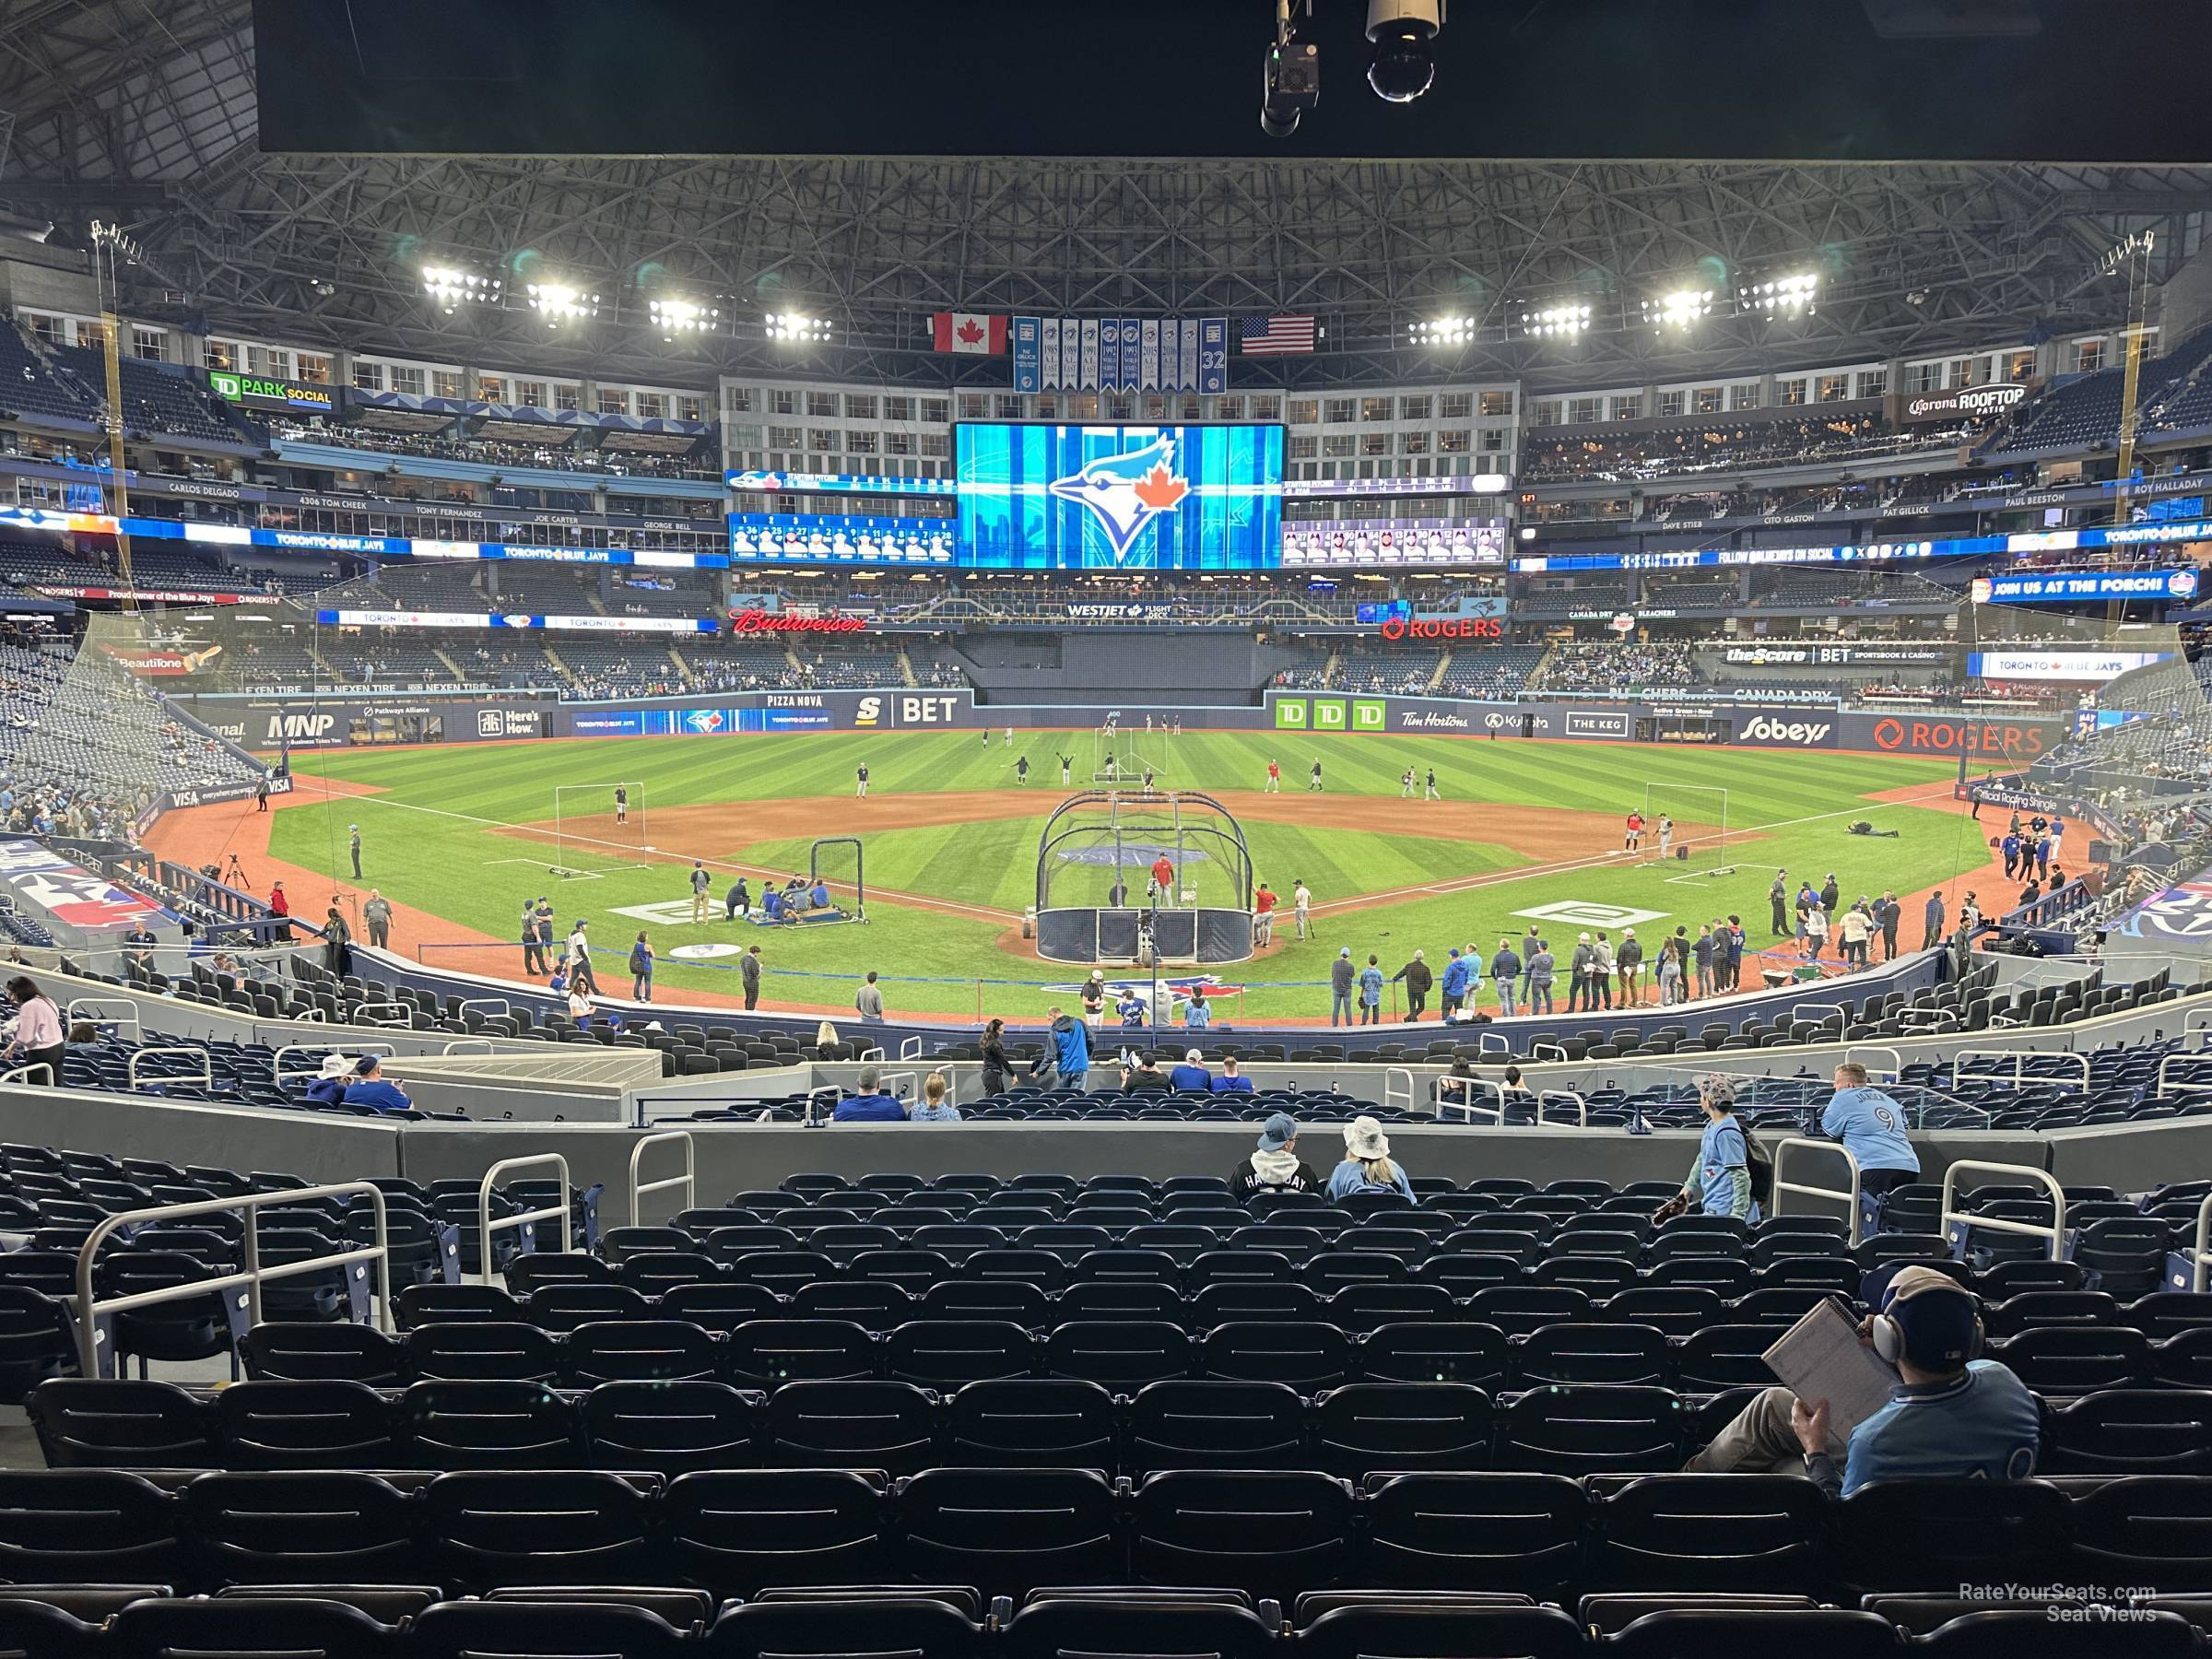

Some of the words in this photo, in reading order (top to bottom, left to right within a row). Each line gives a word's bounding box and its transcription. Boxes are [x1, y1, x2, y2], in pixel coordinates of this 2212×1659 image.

[1103, 346, 1116, 356] 1992
[1202, 351, 1225, 369] 32
[213, 378, 238, 395] TD
[242, 380, 286, 397] PARK
[288, 388, 332, 403] SOCIAL
[1909, 398, 1958, 416] Corona
[1959, 388, 2025, 409] ROOFTOP
[1976, 405, 2005, 415] PATIO
[169, 482, 201, 496] CARLOS
[204, 485, 240, 498] DELGADO
[2135, 485, 2152, 495] ROY
[2156, 478, 2204, 490] HALLADAY
[300, 497, 320, 505] 4306
[322, 499, 340, 507] TOM
[342, 500, 367, 510] CHEEK
[2005, 497, 2026, 507] PAUL
[2028, 494, 2065, 505] BEESTON
[416, 507, 438, 516] TONY
[440, 508, 482, 518] FERNANDEZ
[1883, 509, 1897, 517] PAT
[1899, 506, 1930, 516] GILLICK
[534, 515, 549, 524] JOE
[551, 516, 579, 524] CARTER
[1663, 522, 1680, 530] DAVE
[1683, 521, 1702, 529] STIEB
[1764, 516, 1781, 524] CITO
[1783, 514, 1815, 524] GASTON
[644, 522, 672, 530] GEORGE
[674, 523, 691, 531] BELL
[2104, 527, 2159, 543] TORONTO
[2200, 523, 2212, 536] JA
[276, 534, 326, 547] TORONTO
[338, 537, 361, 549] BLUE
[363, 540, 385, 550] JAYS
[504, 547, 554, 559] TORONTO
[564, 550, 585, 560] BLUE
[587, 552, 609, 561] JAYS
[1719, 551, 1748, 563] FOLLOW
[1806, 547, 1834, 560] SOCIAL
[46, 589, 74, 597] ROGERS
[1994, 582, 2020, 595] JOIN
[2023, 582, 2042, 594] US
[2044, 581, 2065, 593] AT
[2068, 580, 2097, 593] THE
[2100, 577, 2162, 592] PORCH!
[108, 590, 131, 599] Proud
[155, 592, 164, 600] of
[165, 593, 178, 601] the
[179, 593, 196, 602] Blue
[197, 594, 216, 604] Jays
[364, 614, 409, 623] TORONTO
[1067, 605, 1127, 618] WESTJET
[570, 618, 616, 627] TORONTO
[727, 608, 866, 632] Budweiser
[1409, 618, 1501, 638] ROGERS
[1727, 647, 1806, 662] theScore
[1820, 648, 1852, 663] BET
[1854, 651, 1900, 659] SPORTSBOOK
[1908, 651, 1936, 659] CASINO
[120, 658, 182, 669] BeautiTone
[2000, 661, 2048, 670] TORONTO
[2095, 662, 2123, 671] JAYS
[238, 685, 274, 694] EXEN
[276, 685, 302, 694] TIRE
[335, 685, 371, 693] NEXEN
[373, 684, 395, 693] TIRE
[426, 683, 460, 691] NEXEN
[768, 695, 794, 708] PIZZA
[797, 695, 822, 708] NOVA
[1735, 688, 1798, 700] CANADA
[1801, 689, 1832, 701] DRY
[374, 707, 404, 715] Pathways
[506, 711, 539, 722] Here's
[902, 697, 958, 723] BET
[1279, 704, 1303, 724] TD
[1318, 705, 1342, 724] TD
[1357, 706, 1382, 724] TD
[1402, 712, 1424, 727] Tim
[1424, 712, 1468, 728] Hortons
[1505, 714, 1548, 730] Kuota
[1573, 719, 1596, 729] THE
[1599, 719, 1621, 730] KEG
[2079, 713, 2096, 723] MAY
[267, 714, 335, 738] MNP
[507, 724, 534, 735] How.
[1740, 715, 1830, 744] Sobeys
[1912, 724, 2043, 754] ROGERS
[267, 778, 289, 793] VISA
[171, 791, 198, 807] VISA
[2002, 793, 2028, 808] Roofing
[2030, 796, 2057, 811] Shingle
[1875, 1107, 1895, 1132] 9
[1245, 1174, 1307, 1191] HADAY
